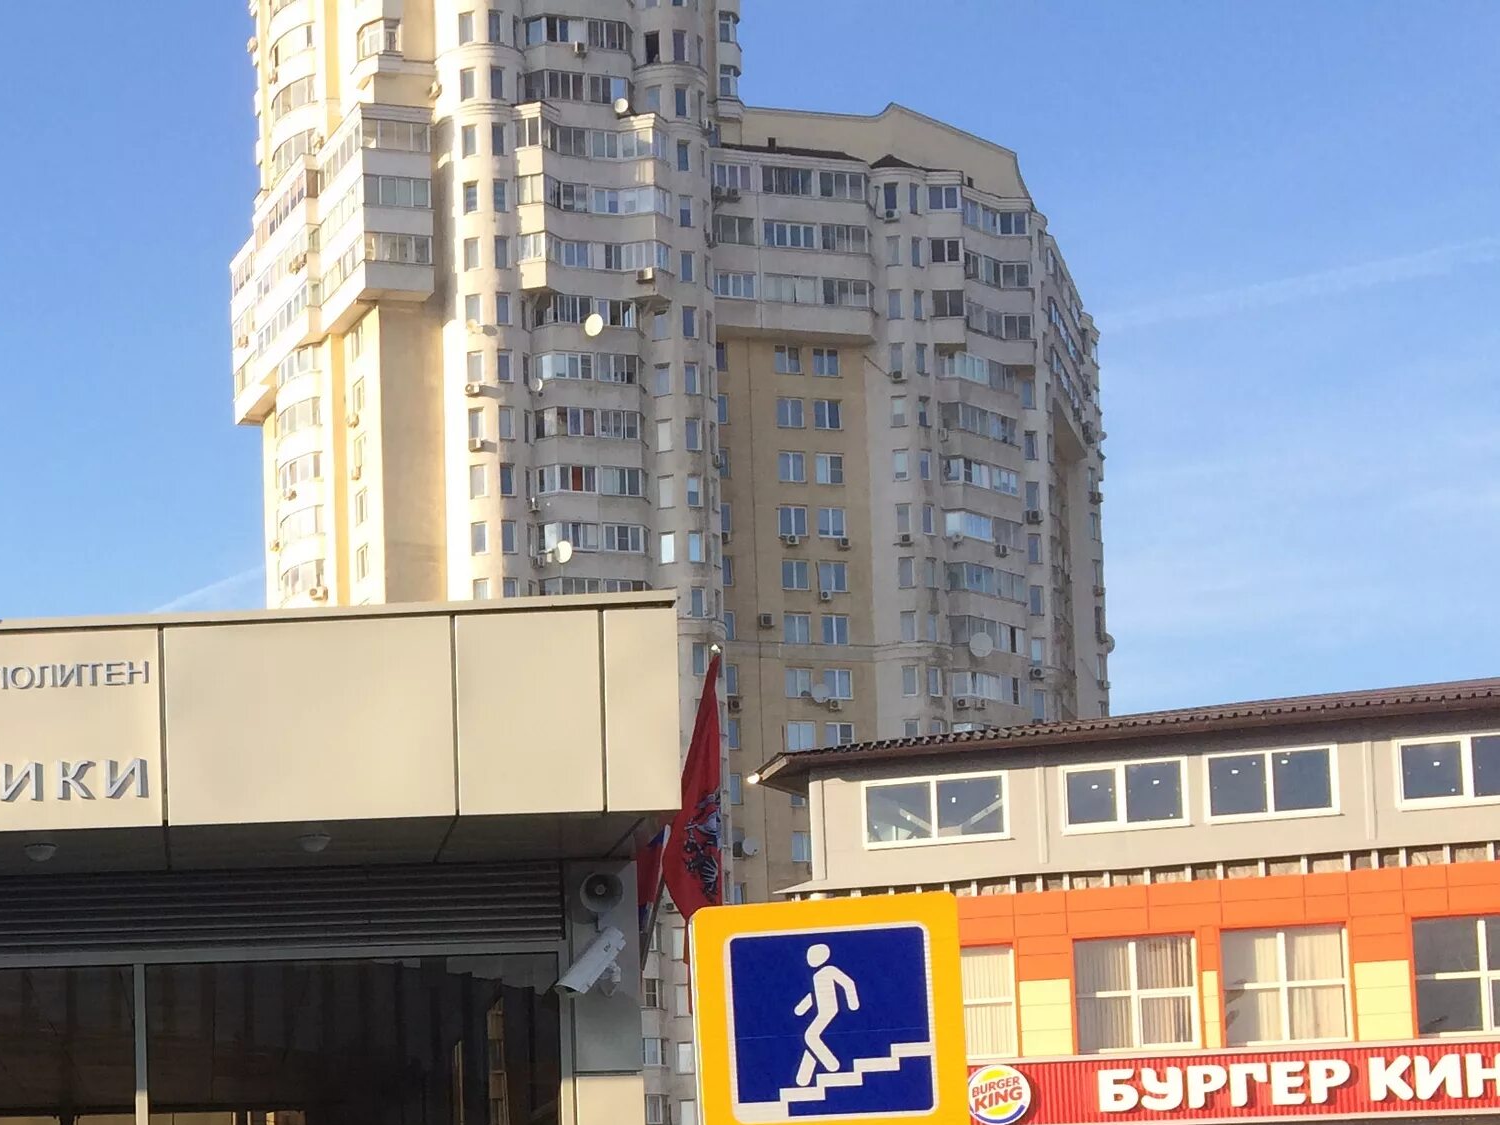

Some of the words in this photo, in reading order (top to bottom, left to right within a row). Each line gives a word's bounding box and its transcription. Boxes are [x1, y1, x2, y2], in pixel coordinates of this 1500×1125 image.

[972, 1076, 1020, 1098] BURGER
[1098, 1059, 1351, 1112] БУРГЕР
[1368, 1052, 1500, 1102] КИН
[975, 1086, 1022, 1113] KING
